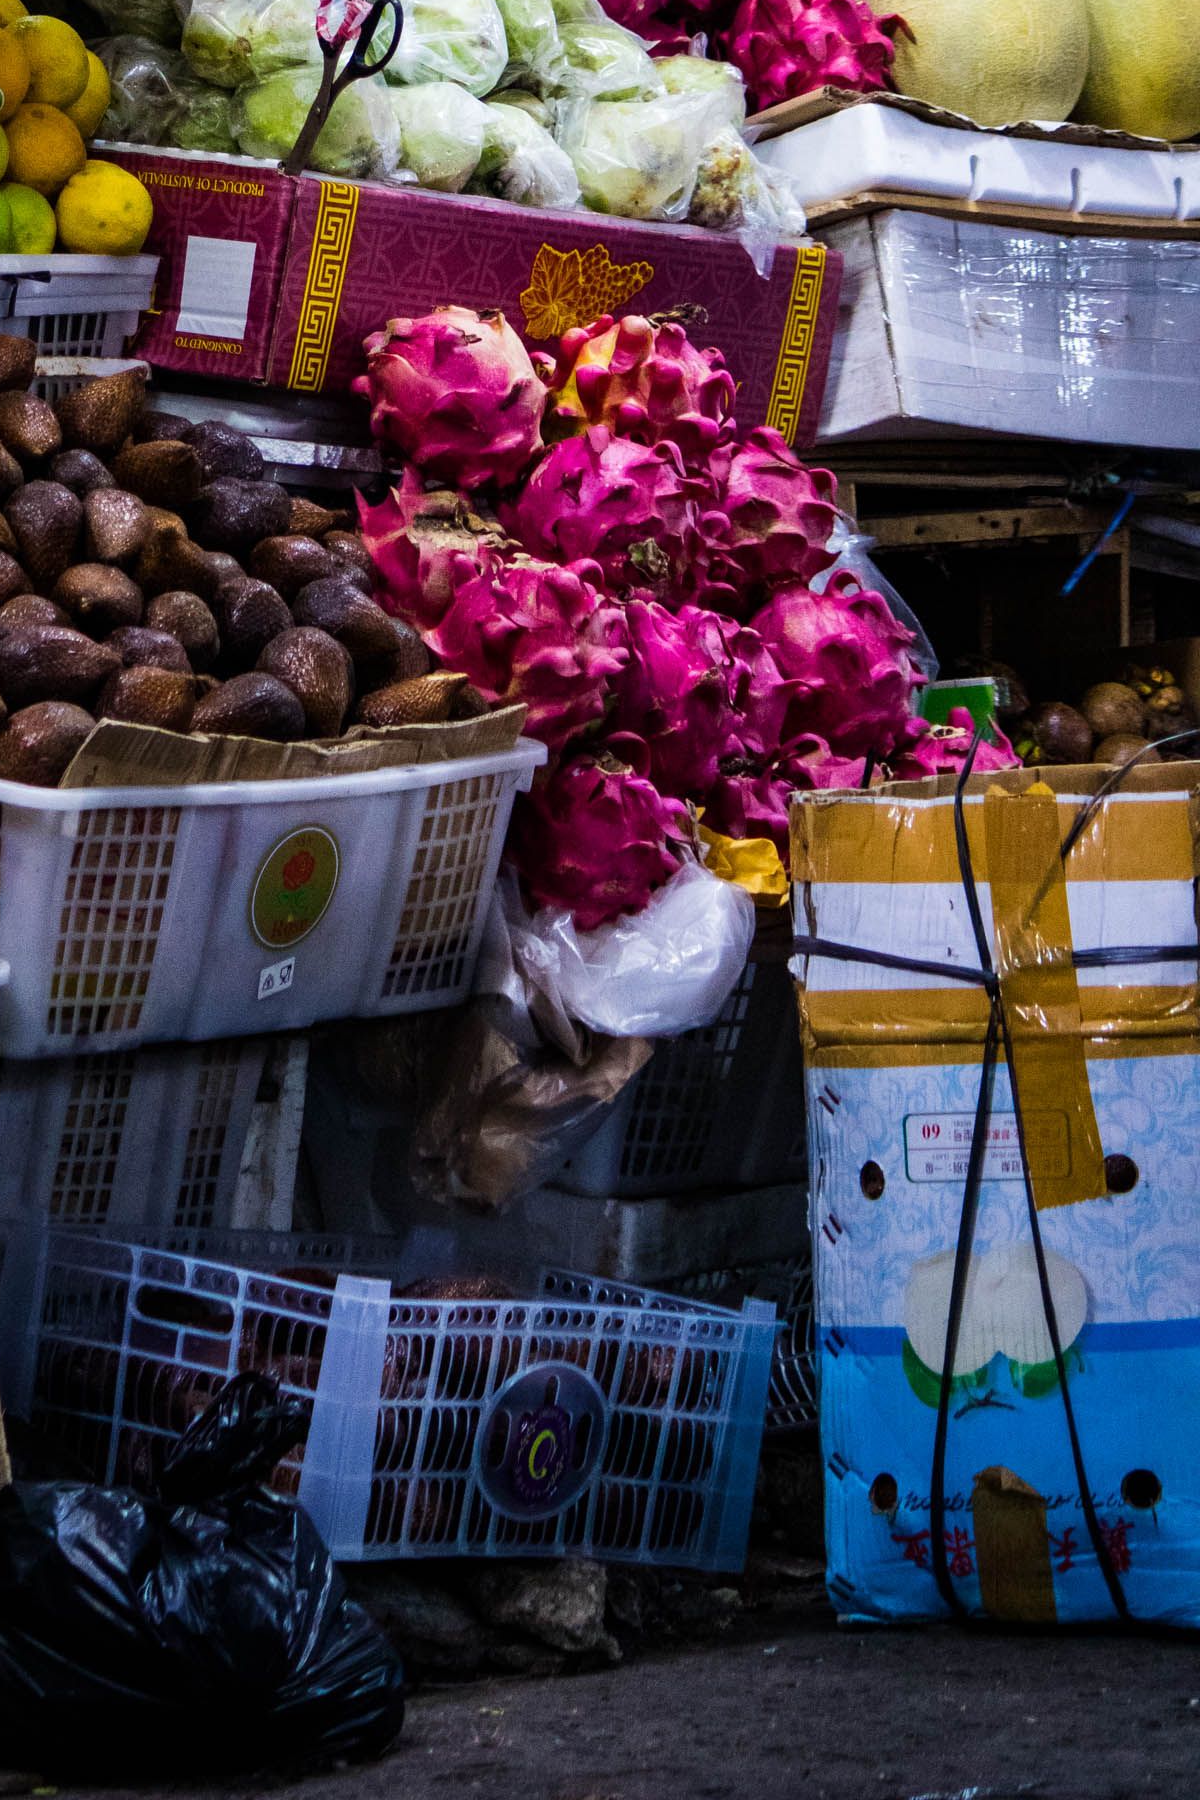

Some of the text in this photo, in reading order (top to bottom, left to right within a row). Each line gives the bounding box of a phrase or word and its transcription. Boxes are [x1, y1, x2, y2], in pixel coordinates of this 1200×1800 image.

[137, 170, 265, 197] PRODUCT OF AUSTRALIA
[175, 336, 243, 355] CONSIGNED TO
[921, 1122, 941, 1141] 60
